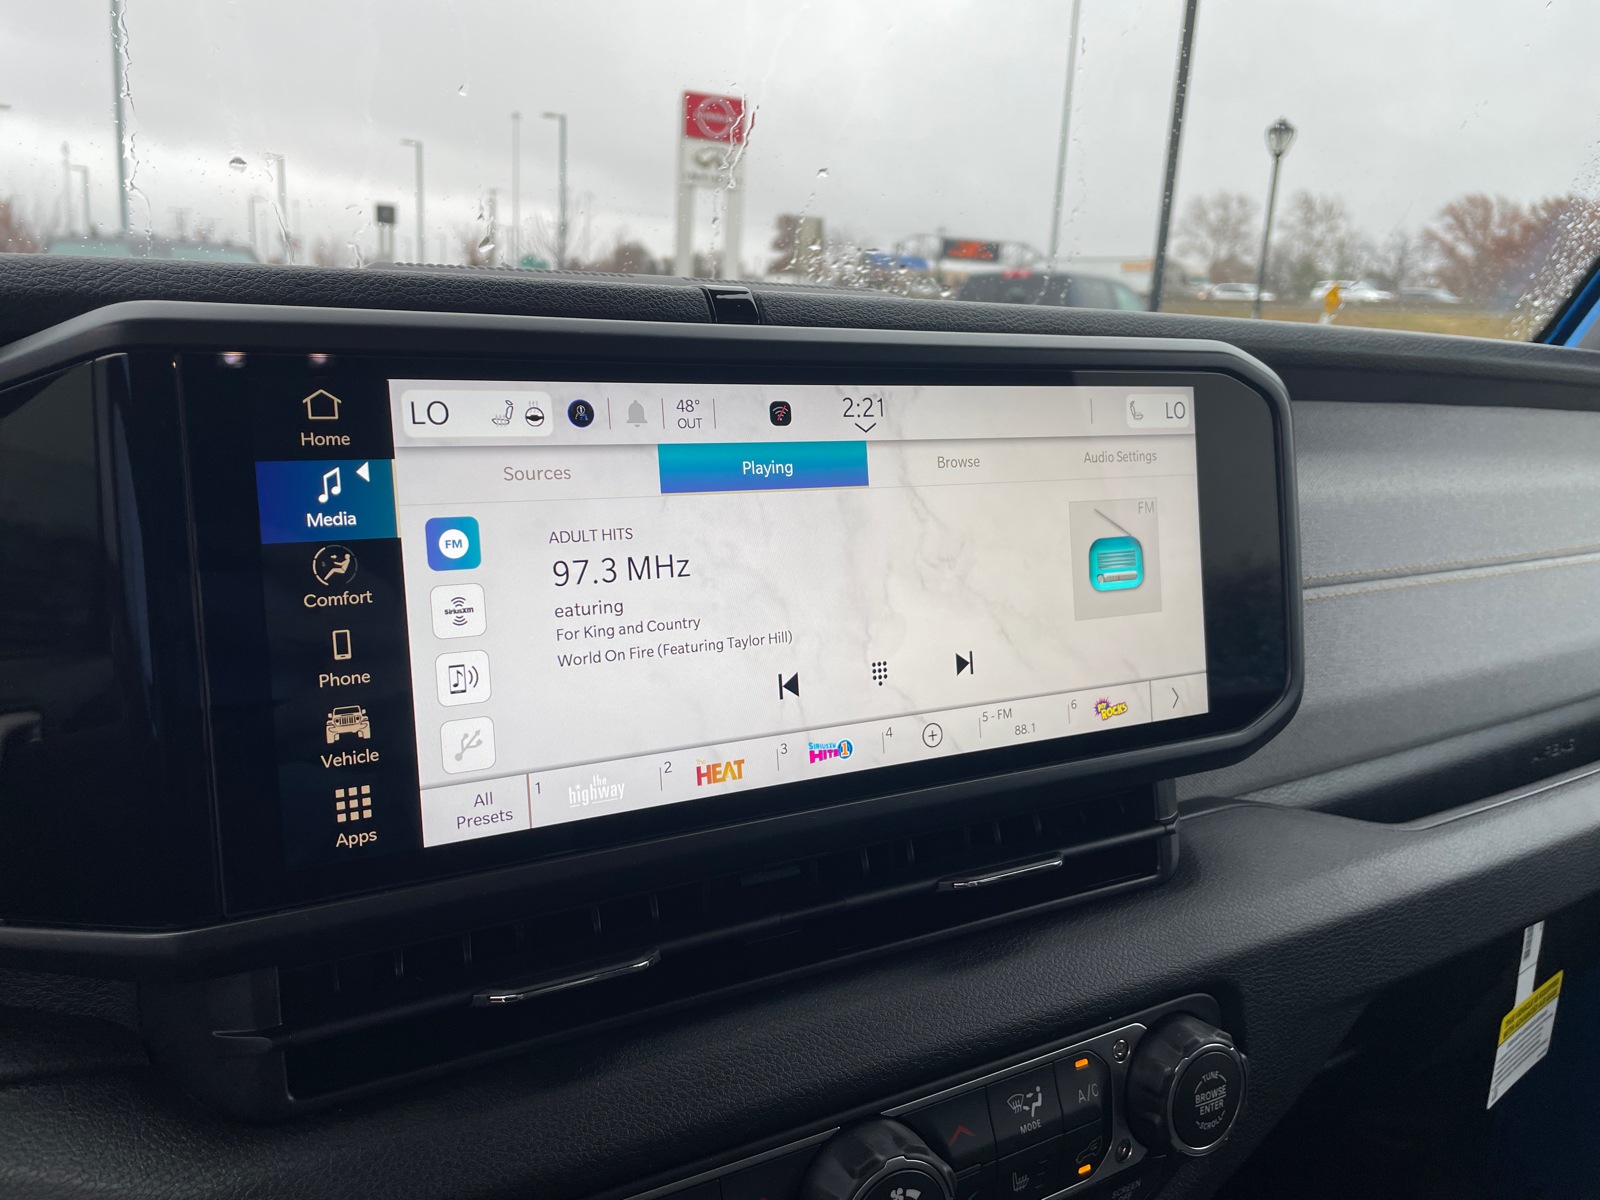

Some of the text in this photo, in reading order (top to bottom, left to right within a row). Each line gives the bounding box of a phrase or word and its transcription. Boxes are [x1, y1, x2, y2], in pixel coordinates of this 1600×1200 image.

[411, 400, 449, 426] LO
[842, 397, 885, 418] 2:21
[1165, 401, 1186, 419] LO
[677, 417, 703, 429] OUT
[300, 432, 351, 446] Home
[936, 456, 981, 469] Browse
[1083, 450, 1157, 464] Audio Settings
[503, 466, 572, 482] Sources
[742, 460, 794, 477] Playing
[1137, 501, 1155, 514] FM
[306, 512, 357, 527] Media
[444, 539, 463, 549] FM
[549, 527, 634, 545] ADULT HITS
[552, 554, 691, 587] 97.3 MHz
[303, 590, 373, 608] Comfort
[554, 600, 624, 619] eaturing
[556, 617, 701, 643] For King and Country
[557, 630, 794, 667] World On Fire (Featuring Taylor Hill)
[318, 671, 371, 688] Phone
[1070, 699, 1077, 710] 6
[1101, 703, 1128, 721] ROCKS
[982, 711, 989, 722] 5
[997, 708, 1013, 719] FM
[885, 727, 893, 738] 4
[1014, 723, 1036, 736] 88.1
[780, 743, 788, 755] 3
[320, 748, 380, 769] Vehicle
[664, 761, 672, 773] 2
[593, 774, 607, 787] the
[696, 759, 745, 786] HEAT
[473, 791, 493, 808] All
[568, 781, 625, 807] highway
[456, 809, 514, 830] Presets
[335, 829, 378, 848] Apps
[1201, 1070, 1219, 1082] TUNE
[1078, 1083, 1099, 1104] A/C
[1195, 1084, 1227, 1104] BROWSE
[1199, 1099, 1224, 1116] ENTER
[1019, 1118, 1042, 1135] MODE
[1199, 1115, 1223, 1130] SCROLL
[1111, 1178, 1142, 1199] SCREEN
